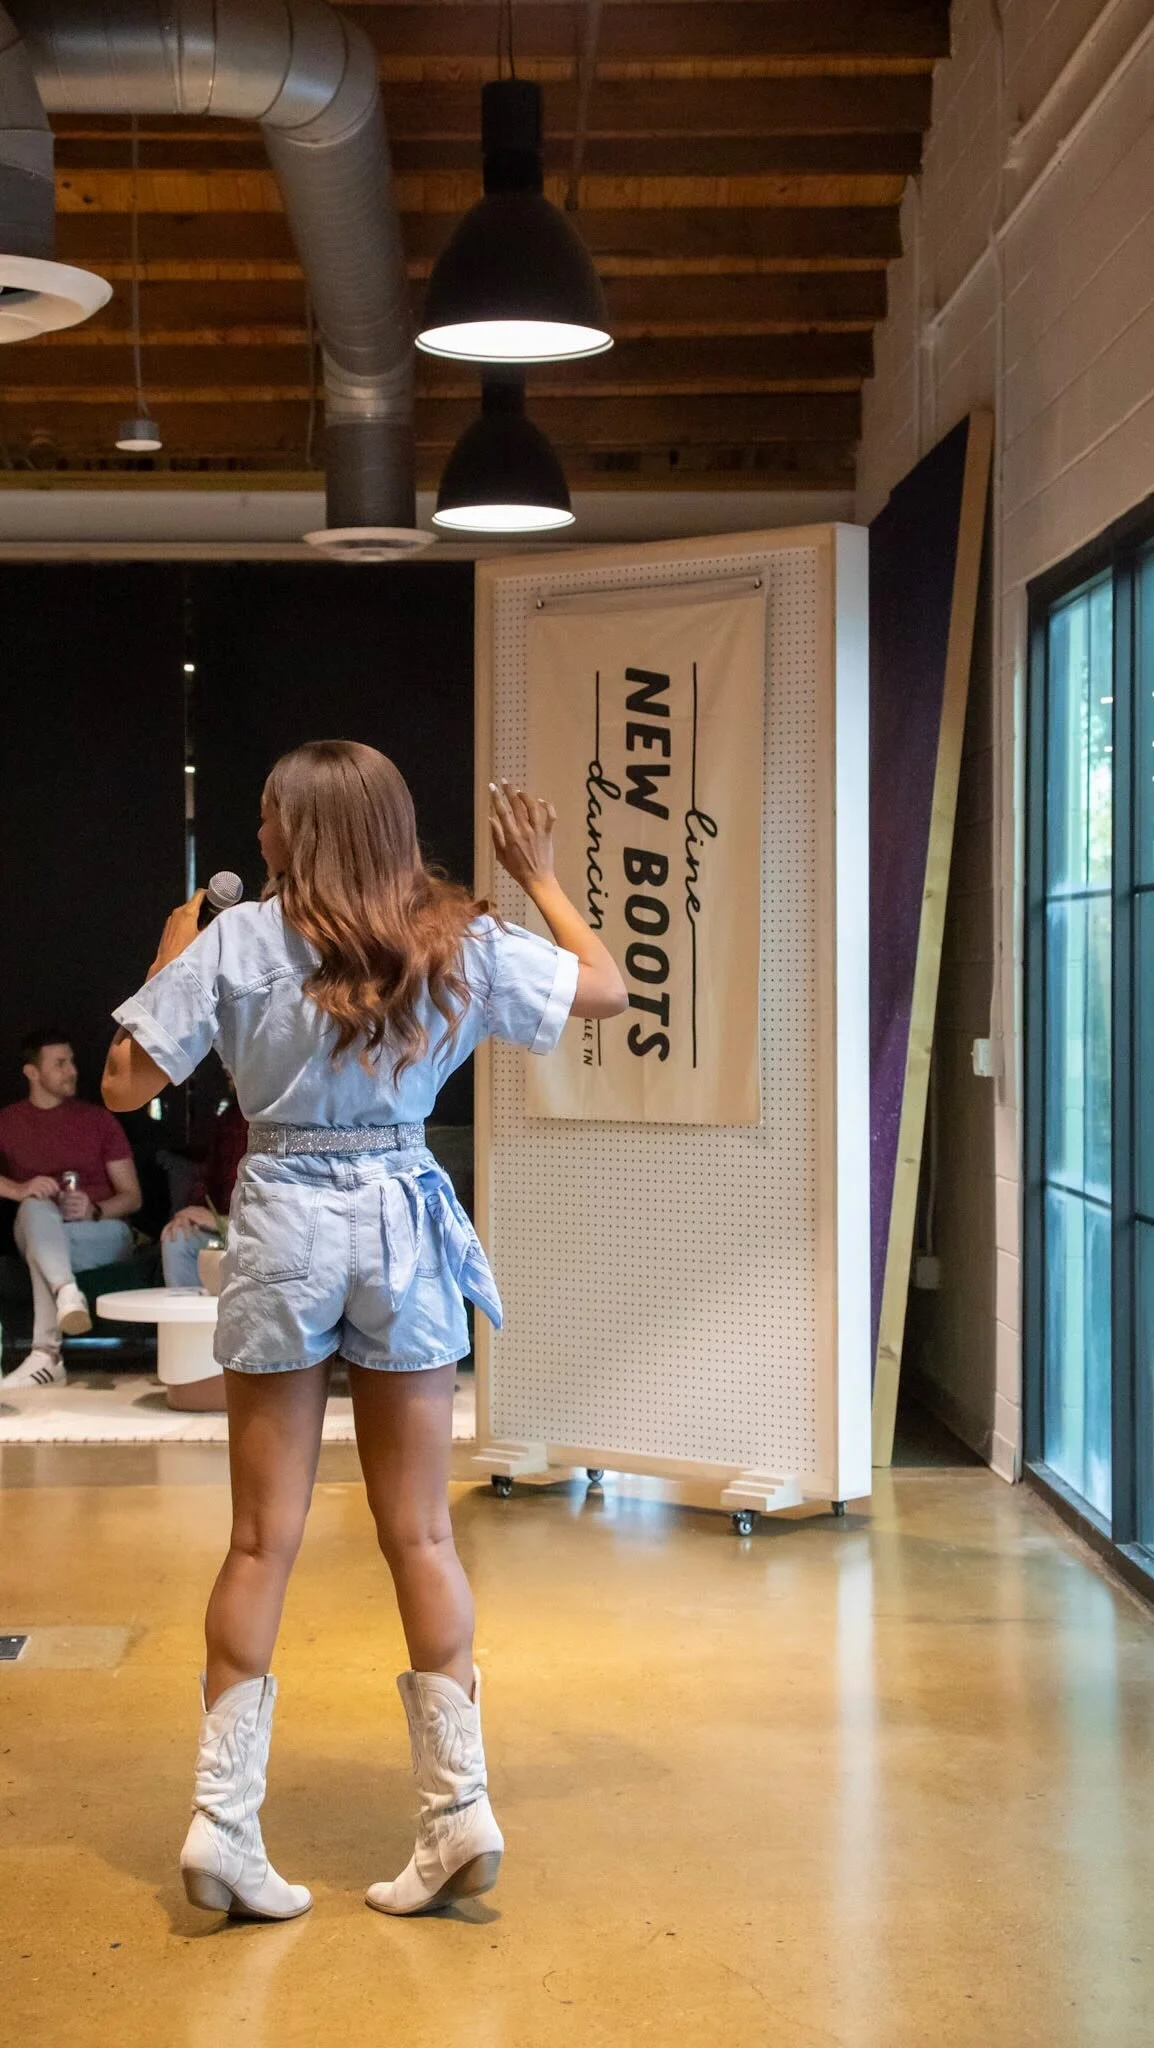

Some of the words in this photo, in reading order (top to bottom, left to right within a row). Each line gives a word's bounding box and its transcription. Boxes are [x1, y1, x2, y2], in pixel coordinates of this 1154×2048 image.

[624, 667, 671, 821] NEW
[684, 809, 718, 926] line
[623, 846, 670, 1062] BOOTS
[582, 1048, 593, 1066] TN
